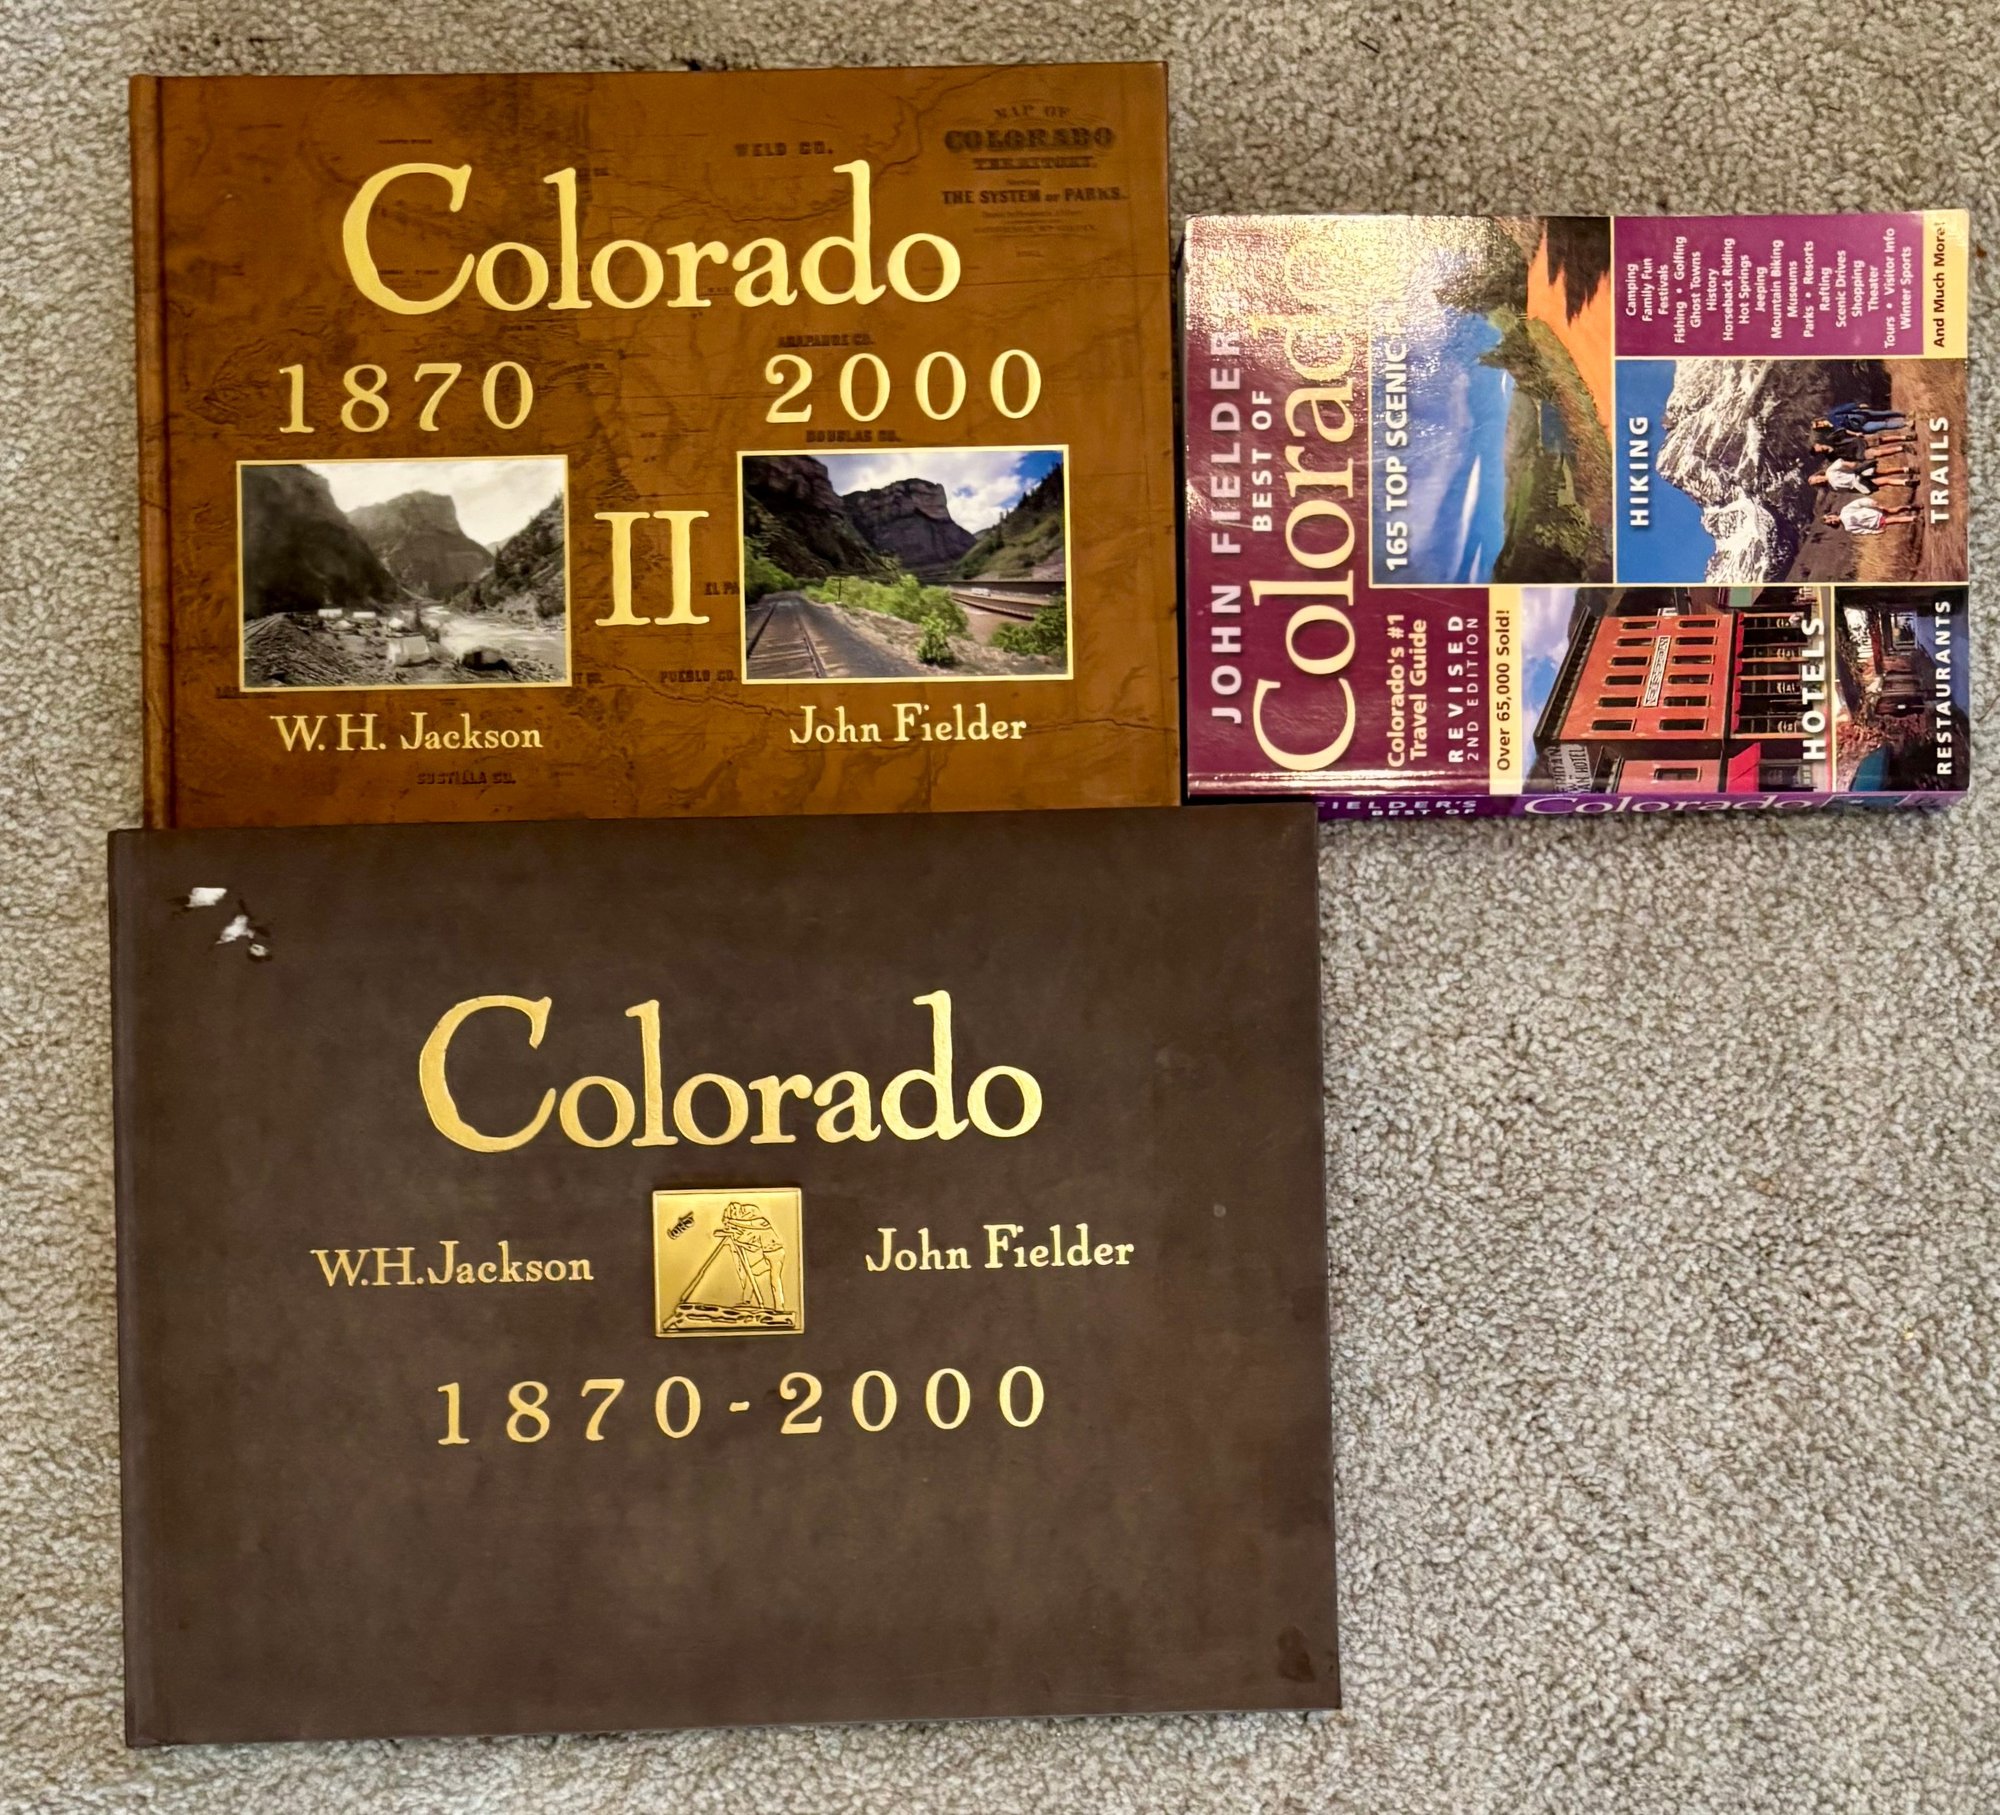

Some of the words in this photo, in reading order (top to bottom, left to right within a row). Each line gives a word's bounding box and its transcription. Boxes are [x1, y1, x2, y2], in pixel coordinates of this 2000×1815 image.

[1044, 105, 1070, 118] OF
[944, 126, 1115, 152] COLORADO
[942, 190, 974, 204] THE
[980, 189, 1040, 203] SYSTEM
[343, 160, 961, 314] Colorado
[1673, 237, 1687, 280] Golfing
[1722, 238, 1735, 276] Riding
[1883, 228, 1895, 259] Info
[1934, 221, 1948, 268] More!
[1641, 258, 1652, 279] Fun
[1690, 252, 1701, 289] Towns
[1738, 255, 1752, 298] Springs
[1770, 240, 1784, 282] Biking
[1803, 241, 1814, 284] Resorts
[1835, 250, 1846, 287] Drives
[1884, 260, 1895, 295] Visitor
[1900, 247, 1913, 285] Sports
[1625, 264, 1639, 315] Camping
[1641, 284, 1655, 321] Family
[1657, 264, 1669, 314] Festivals
[1706, 269, 1719, 310] History
[1722, 280, 1733, 340] Horseback
[1754, 267, 1768, 312] Jeeping
[1771, 282, 1782, 338] Mountain
[1787, 261, 1798, 317] Museums
[1819, 268, 1832, 310] Rafting
[1836, 291, 1846, 327] Scenic
[1851, 260, 1865, 317] Shopping
[1868, 266, 1879, 311] Theater
[1900, 289, 1911, 329] Winter
[1933, 273, 1944, 312] Much
[1674, 302, 1687, 343] Fishing
[1690, 293, 1701, 328] Ghost
[1739, 303, 1749, 324] Hot
[1803, 306, 1814, 337] Parks
[1884, 317, 1895, 348] Tours
[1933, 319, 1944, 347] And
[279, 361, 533, 433] 1870
[766, 350, 1041, 423] 2000
[1383, 339, 1411, 446] SCENIC
[1252, 391, 1272, 430] OF
[1252, 449, 1272, 531] BEST
[1386, 456, 1411, 511] TOP
[1630, 417, 1649, 525] HIKING
[1929, 417, 1949, 523] TRAILS
[1248, 228, 1357, 772] Colorado
[1386, 517, 1411, 570] 165
[594, 511, 709, 626] II
[1387, 615, 1404, 638] #1
[1496, 611, 1509, 656] Sold!
[1212, 586, 1241, 723] JOHN
[1409, 620, 1426, 686] Guide
[1466, 619, 1478, 706] EDITION
[659, 669, 711, 684] PUEBLO
[1448, 616, 1463, 762] REVISED
[1496, 663, 1511, 721] 65,000
[1800, 615, 1827, 759] HOTELS
[1935, 602, 1951, 774] RESTAURANTS
[401, 712, 543, 749] Jackson
[790, 706, 882, 743] John
[893, 703, 1026, 741] Fielder
[1386, 654, 1405, 767] Colorado's
[1409, 694, 1427, 760] Travel
[1467, 722, 1478, 760] 2ND
[1497, 728, 1510, 770] Over
[1524, 795, 1812, 815] Colorado
[419, 990, 1042, 1152] Colorado
[866, 1228, 971, 1271] John
[983, 1223, 1134, 1268] Fielder
